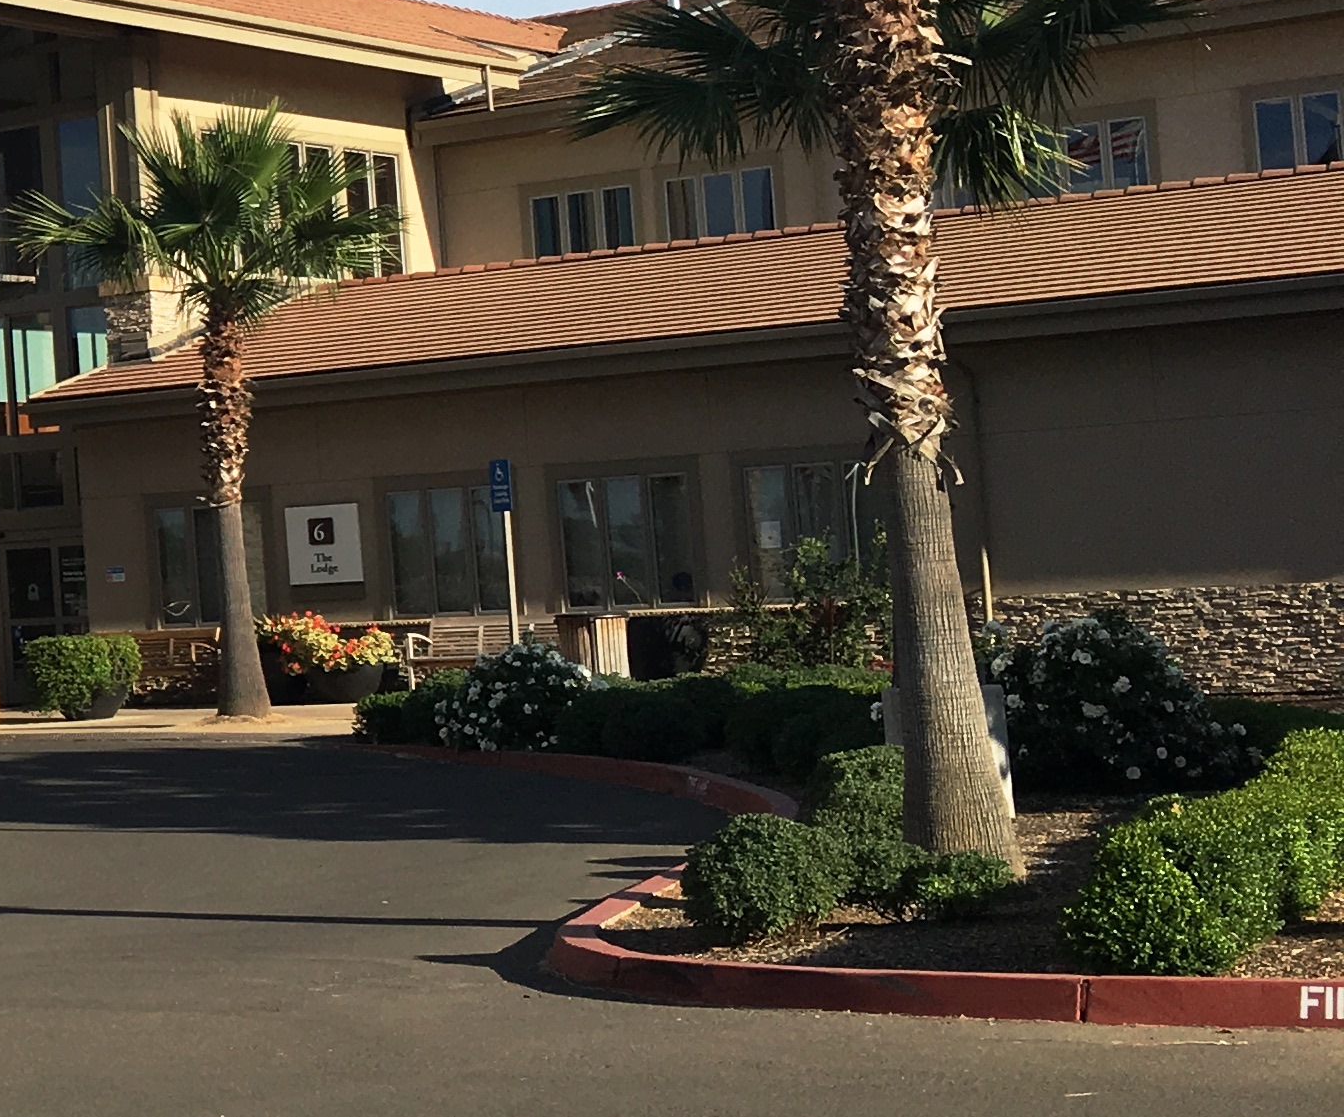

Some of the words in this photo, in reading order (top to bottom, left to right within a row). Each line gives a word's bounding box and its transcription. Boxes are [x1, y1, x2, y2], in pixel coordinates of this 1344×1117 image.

[313, 523, 325, 541] 6
[314, 553, 333, 562] The
[310, 564, 339, 575] Lodge
